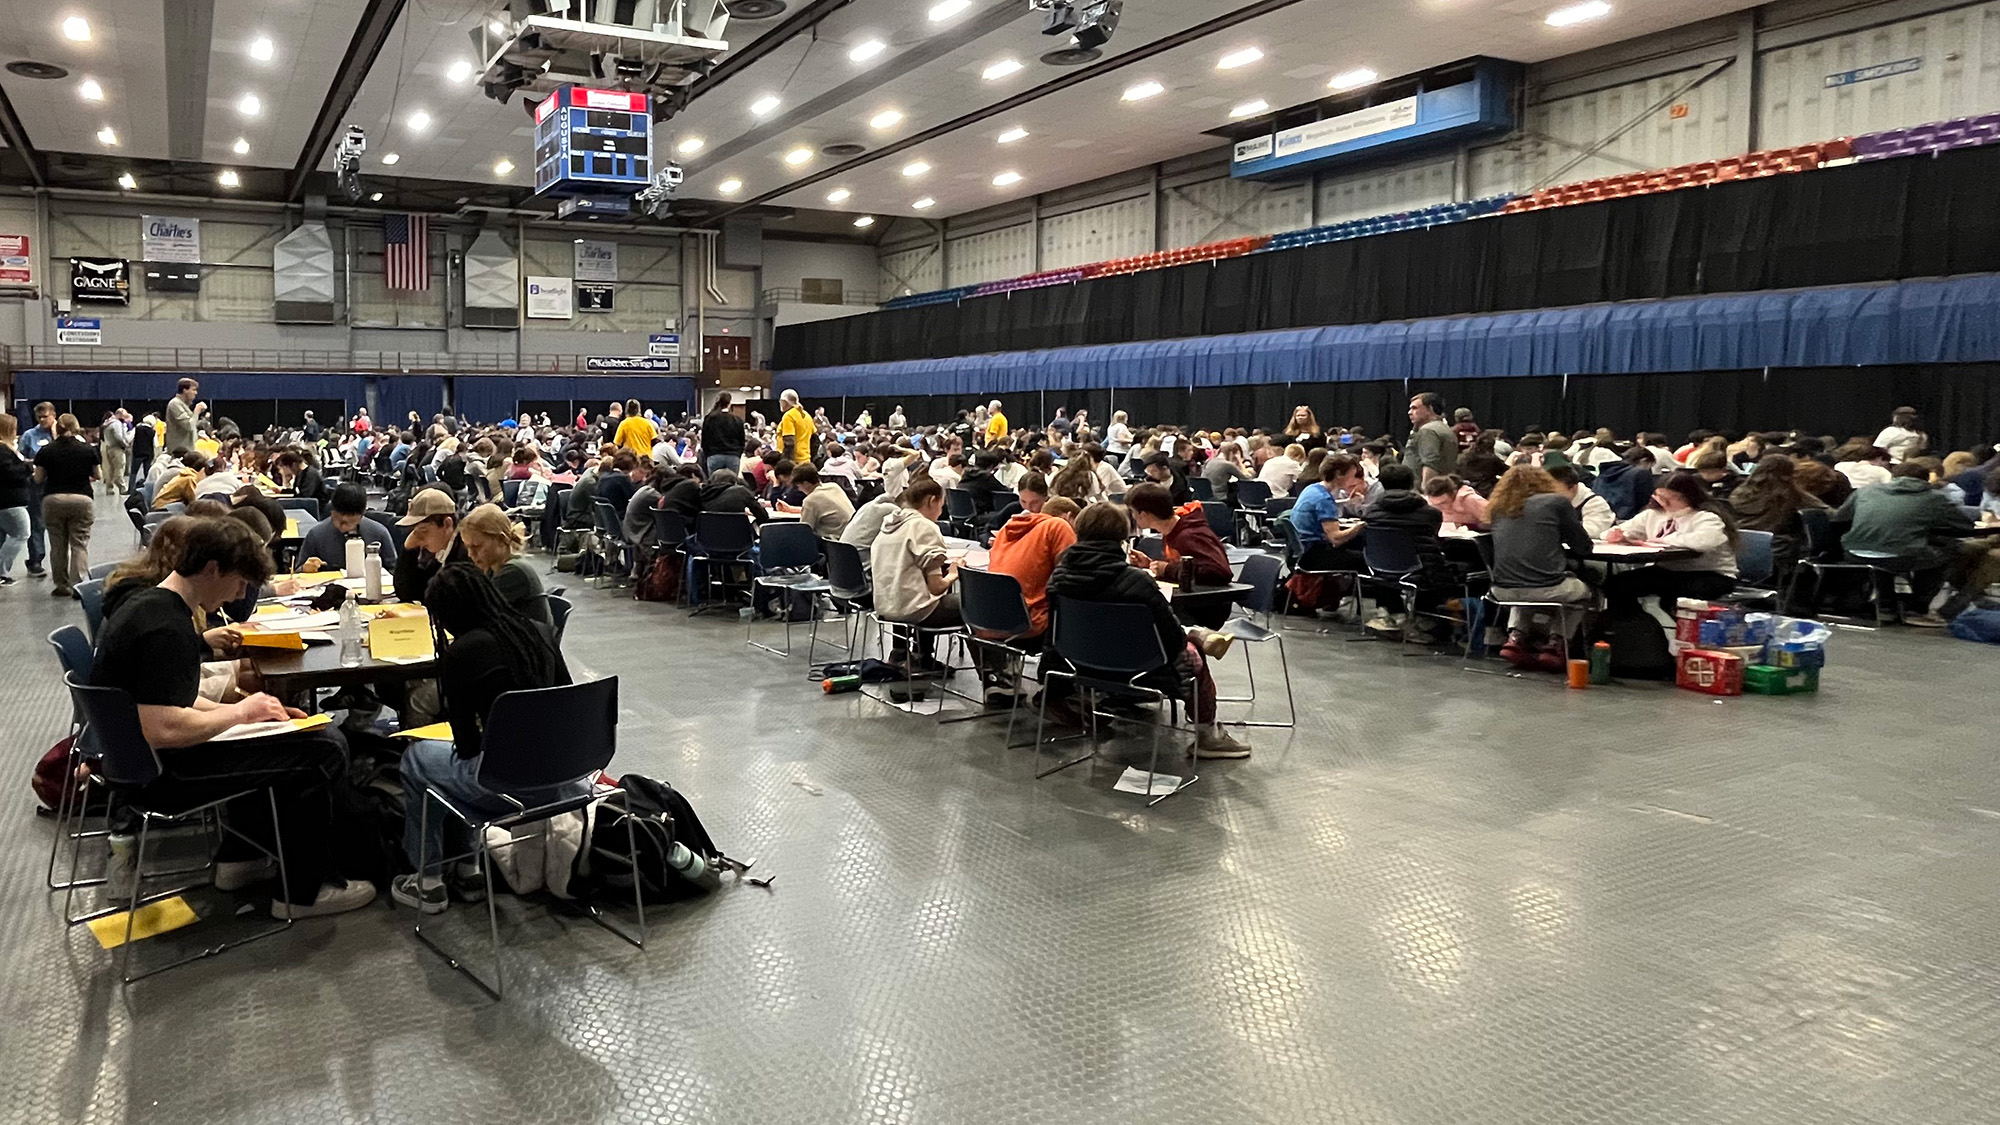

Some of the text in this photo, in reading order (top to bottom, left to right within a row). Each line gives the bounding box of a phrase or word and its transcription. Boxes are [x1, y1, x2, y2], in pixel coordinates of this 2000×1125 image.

[150, 222, 193, 239] Charlie's
[73, 276, 116, 288] GAGNE
[653, 359, 669, 368] Bank
